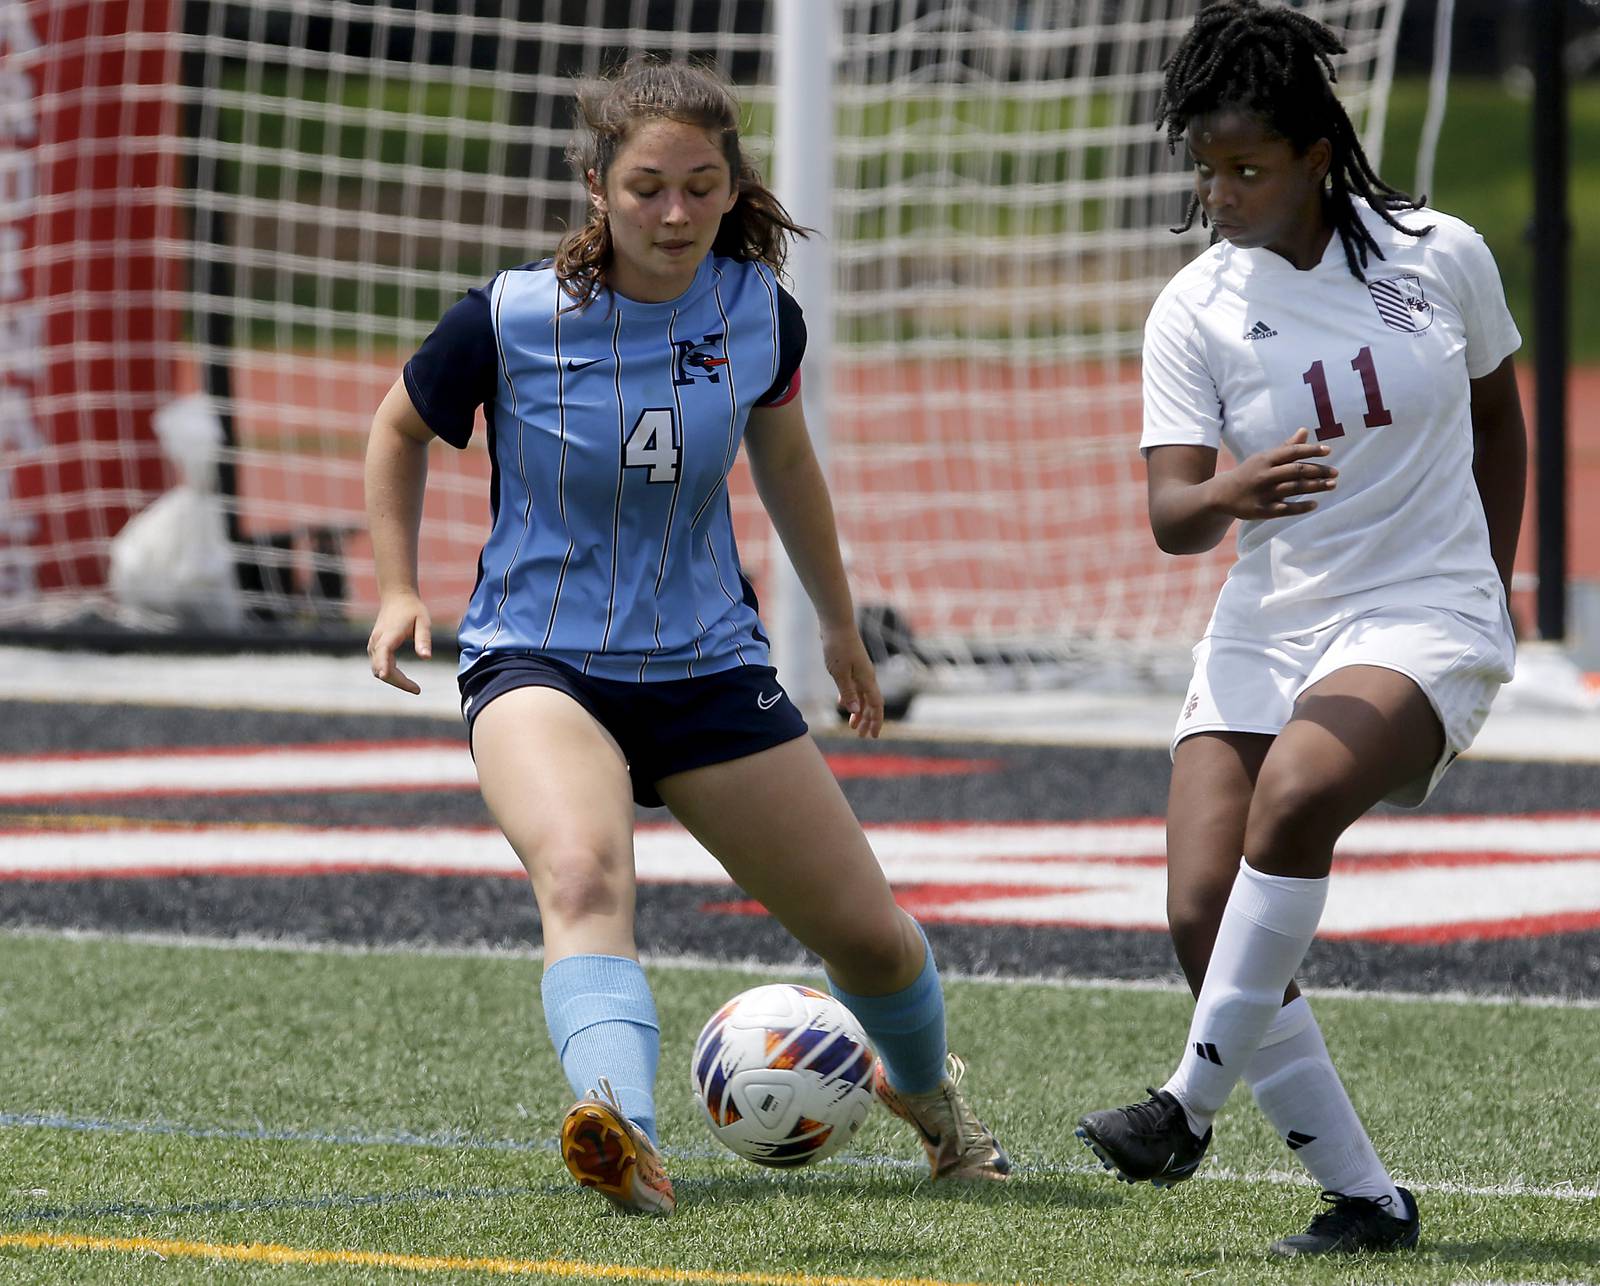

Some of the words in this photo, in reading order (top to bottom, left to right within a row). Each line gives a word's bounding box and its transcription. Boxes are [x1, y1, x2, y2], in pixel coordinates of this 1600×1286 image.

[1243, 330, 1278, 340] adidas
[1302, 346, 1393, 442] 11
[622, 407, 681, 484] 4
